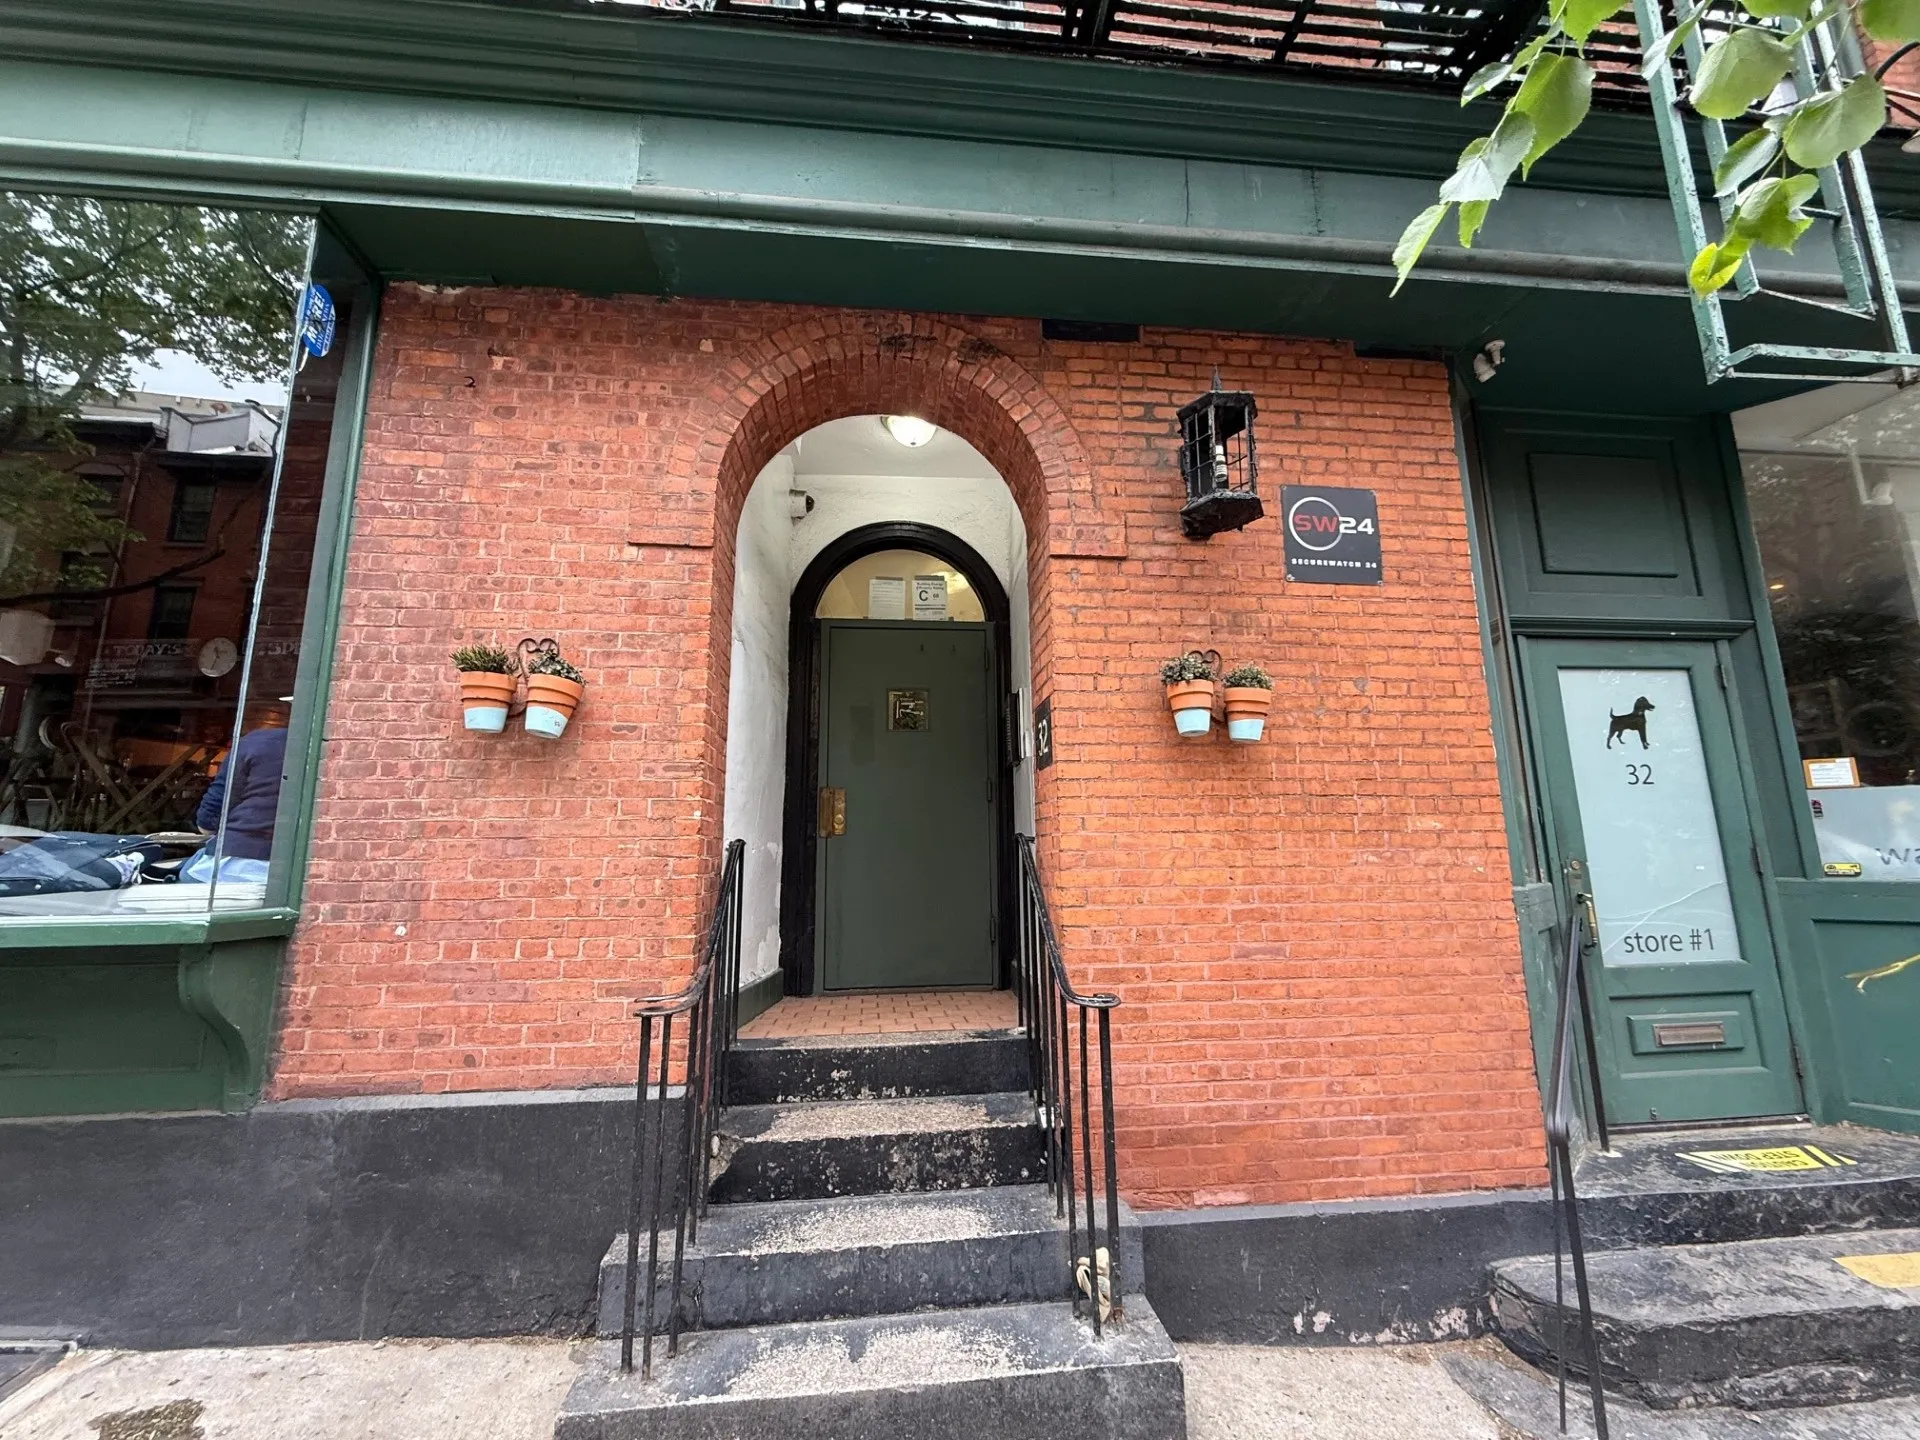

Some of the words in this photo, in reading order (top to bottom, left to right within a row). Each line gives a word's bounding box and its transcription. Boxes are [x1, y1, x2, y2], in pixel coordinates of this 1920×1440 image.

[306, 291, 325, 344] MRE!
[1293, 513, 1375, 535] SW24
[1291, 558, 1362, 568] SECUREWATCH
[919, 590, 928, 601] C
[1038, 718, 1049, 757] 32
[1625, 763, 1655, 786] 32
[1623, 932, 1683, 954] store
[1689, 928, 1715, 953] #1
[1761, 1150, 1801, 1160] STEP
